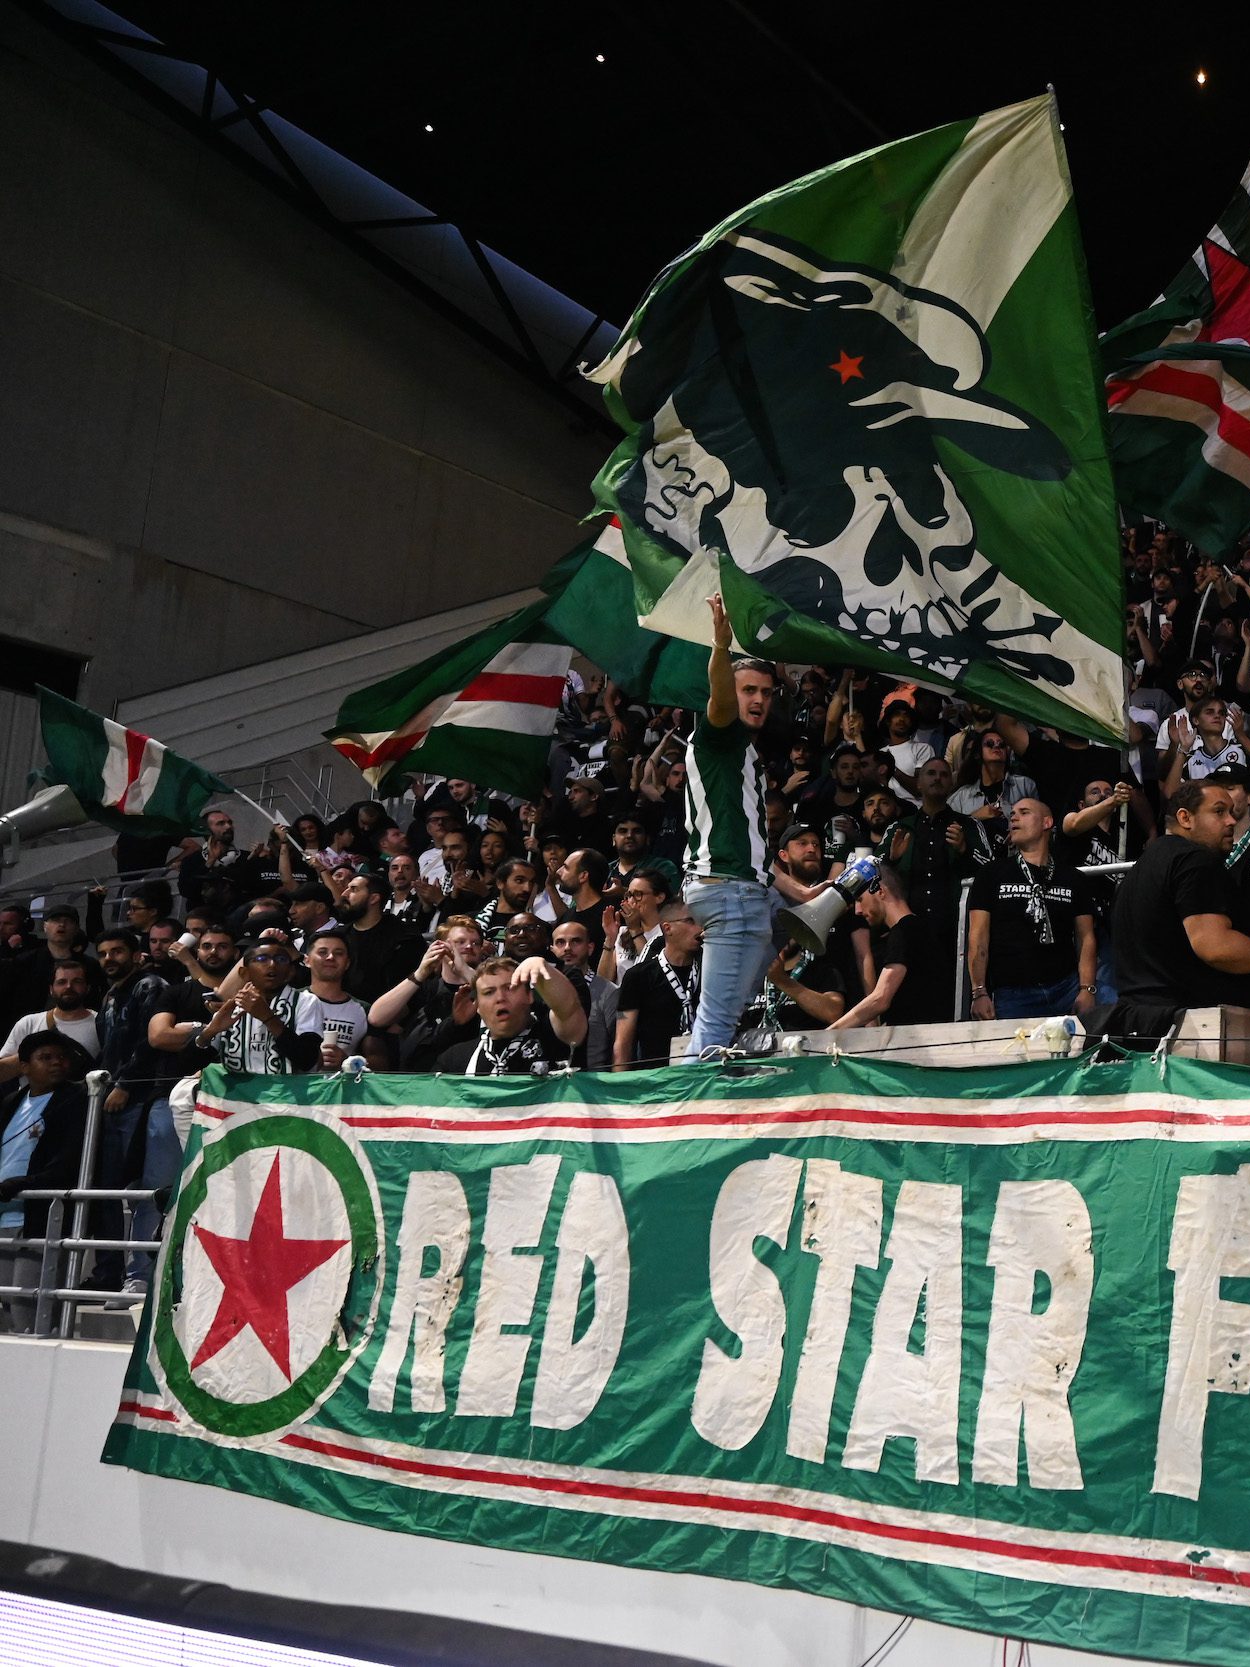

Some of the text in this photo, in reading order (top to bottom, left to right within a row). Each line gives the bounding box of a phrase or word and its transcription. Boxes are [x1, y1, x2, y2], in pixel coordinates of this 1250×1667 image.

[999, 885, 1072, 897] STADE AUER
[367, 1153, 631, 1432] RED
[690, 1152, 1094, 1492] STAR
